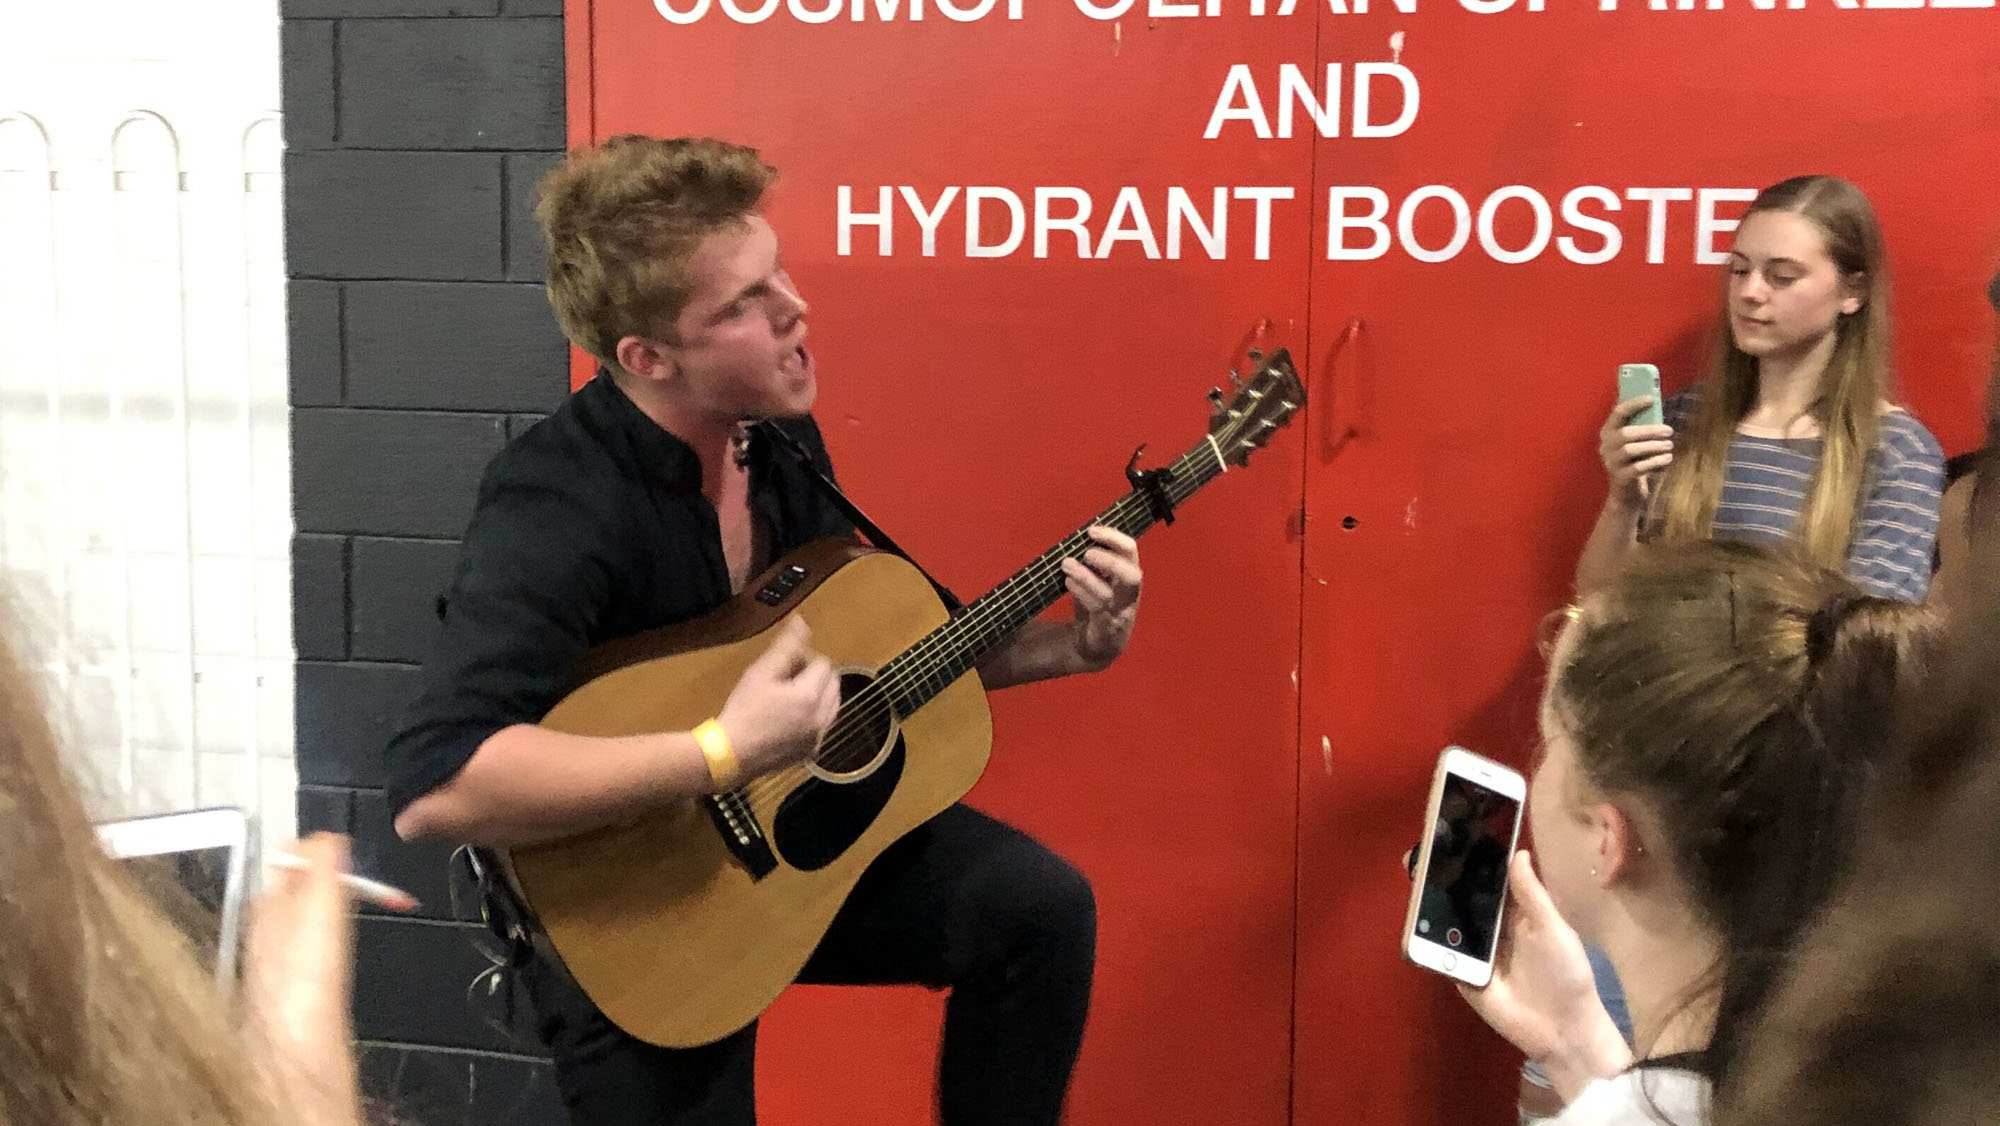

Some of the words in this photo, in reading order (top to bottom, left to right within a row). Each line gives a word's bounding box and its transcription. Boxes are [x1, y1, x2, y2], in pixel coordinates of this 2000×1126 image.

[1202, 61, 1421, 139] AND
[836, 185, 1296, 261] HYDRANT
[1326, 184, 1759, 265] BOOSTE
